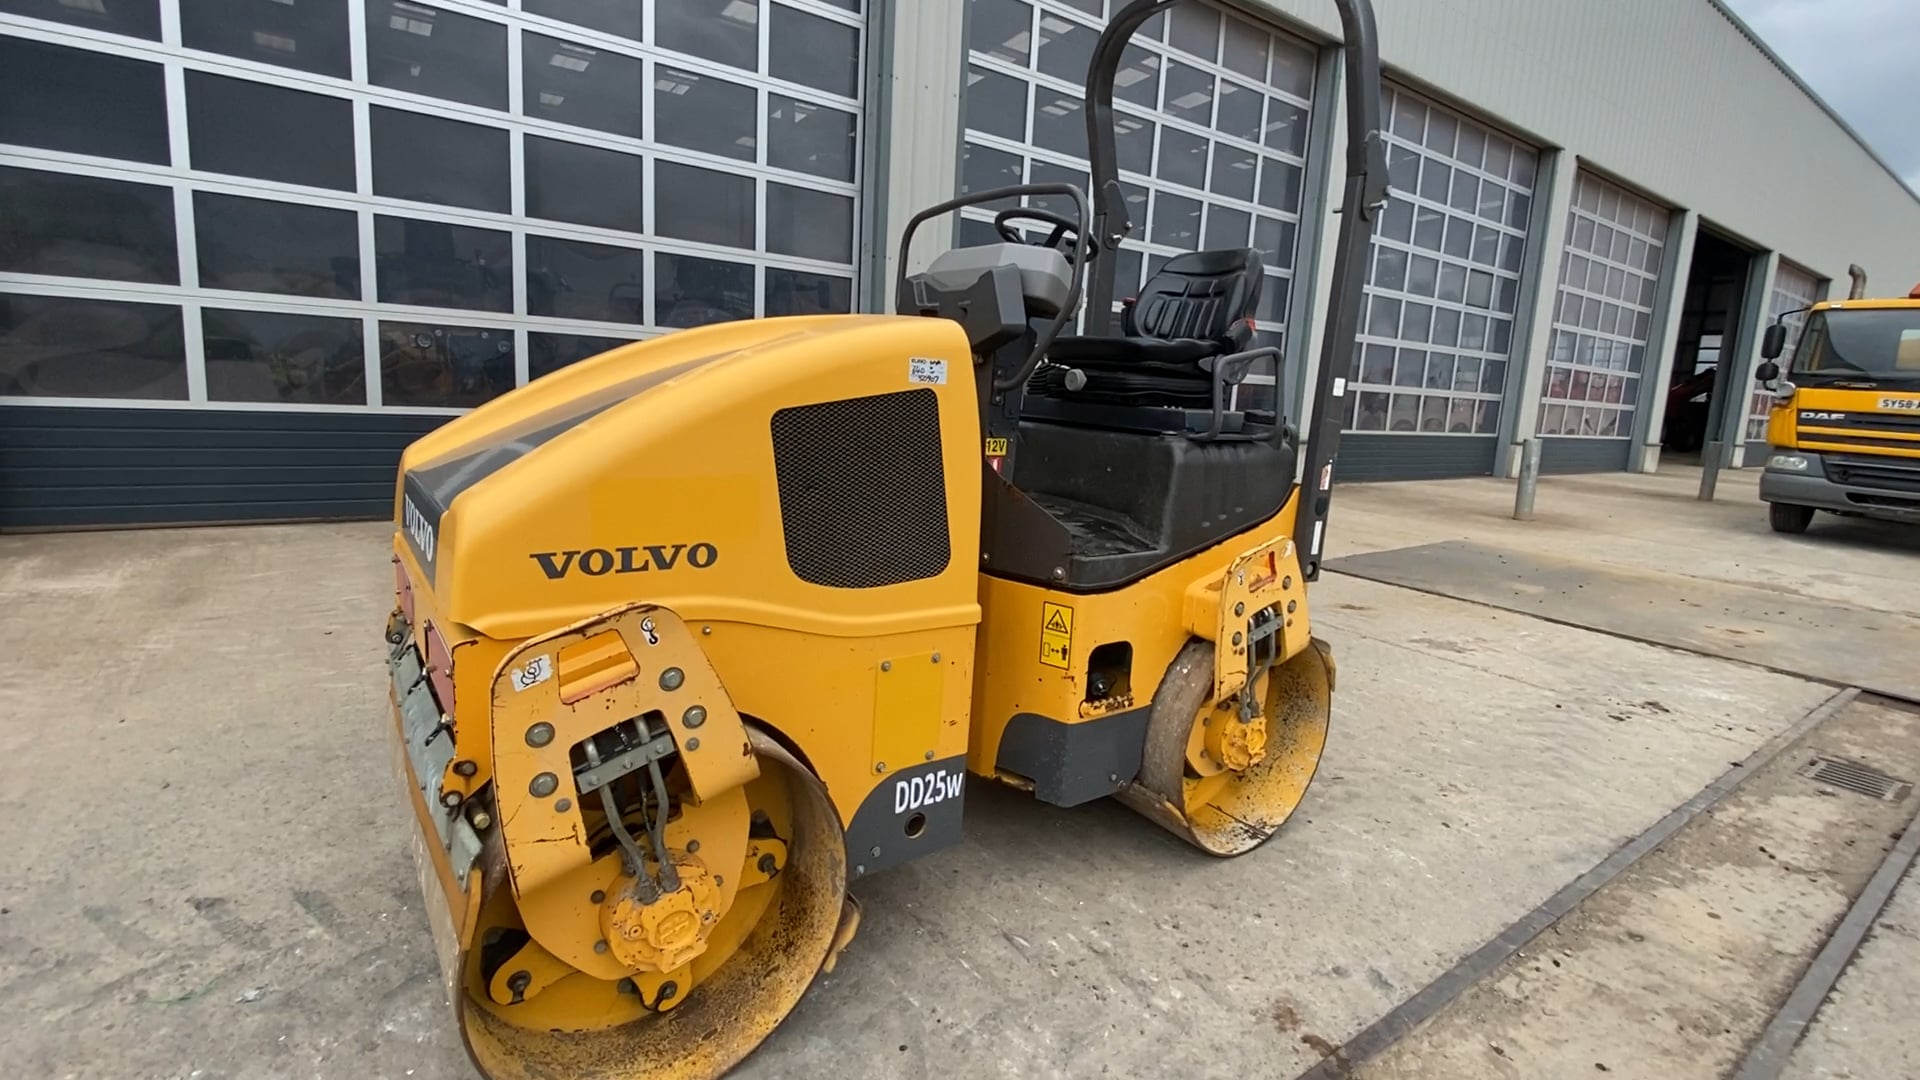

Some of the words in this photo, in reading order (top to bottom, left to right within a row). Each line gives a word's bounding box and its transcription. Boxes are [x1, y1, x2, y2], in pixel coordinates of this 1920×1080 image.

[1800, 412, 1846, 420] DAF
[987, 440, 1005, 453] 12V
[405, 493, 434, 562] VOLVO
[529, 542, 718, 580] VOLVO
